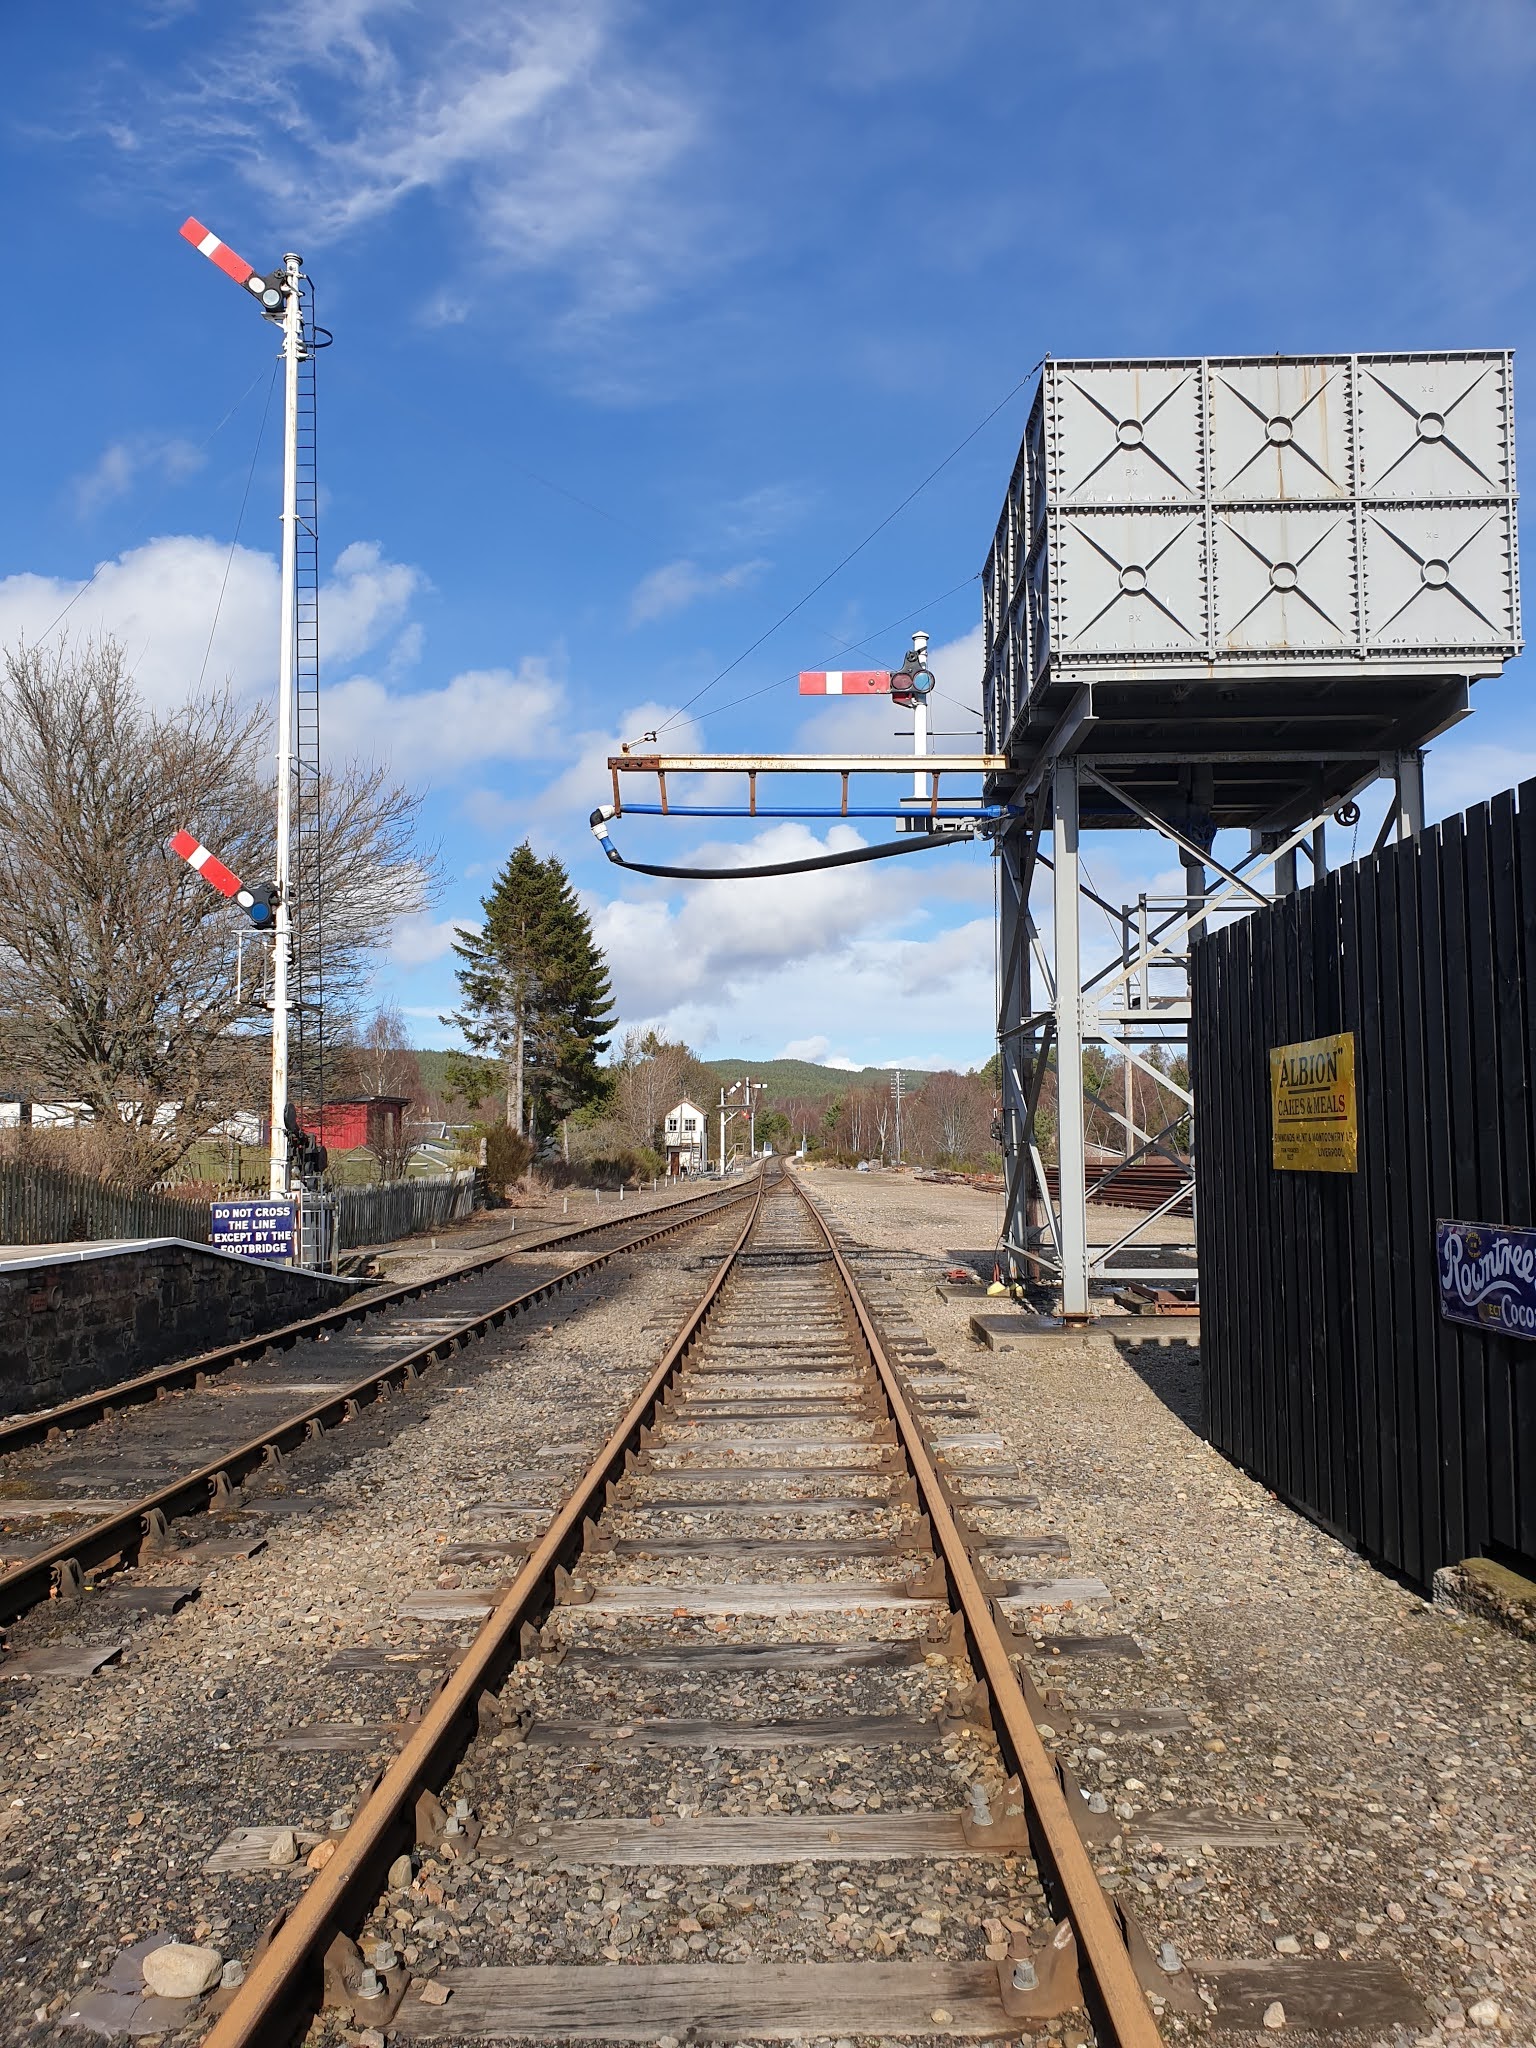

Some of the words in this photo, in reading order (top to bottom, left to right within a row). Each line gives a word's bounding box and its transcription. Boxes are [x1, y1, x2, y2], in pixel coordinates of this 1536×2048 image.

[1306, 1097, 1313, 1114] &
[1313, 1094, 1346, 1114] MEALS
[215, 1209, 230, 1219] DO
[232, 1208, 253, 1218] NOT
[255, 1207, 290, 1217] CROSS
[228, 1220, 249, 1230] THE
[252, 1219, 276, 1229] LINE
[214, 1232, 253, 1243] EXCEPT
[255, 1231, 269, 1241] BY
[271, 1230, 291, 1240] THE
[1442, 1232, 1536, 1307] Rowntree
[1501, 1294, 1536, 1328] Coco
